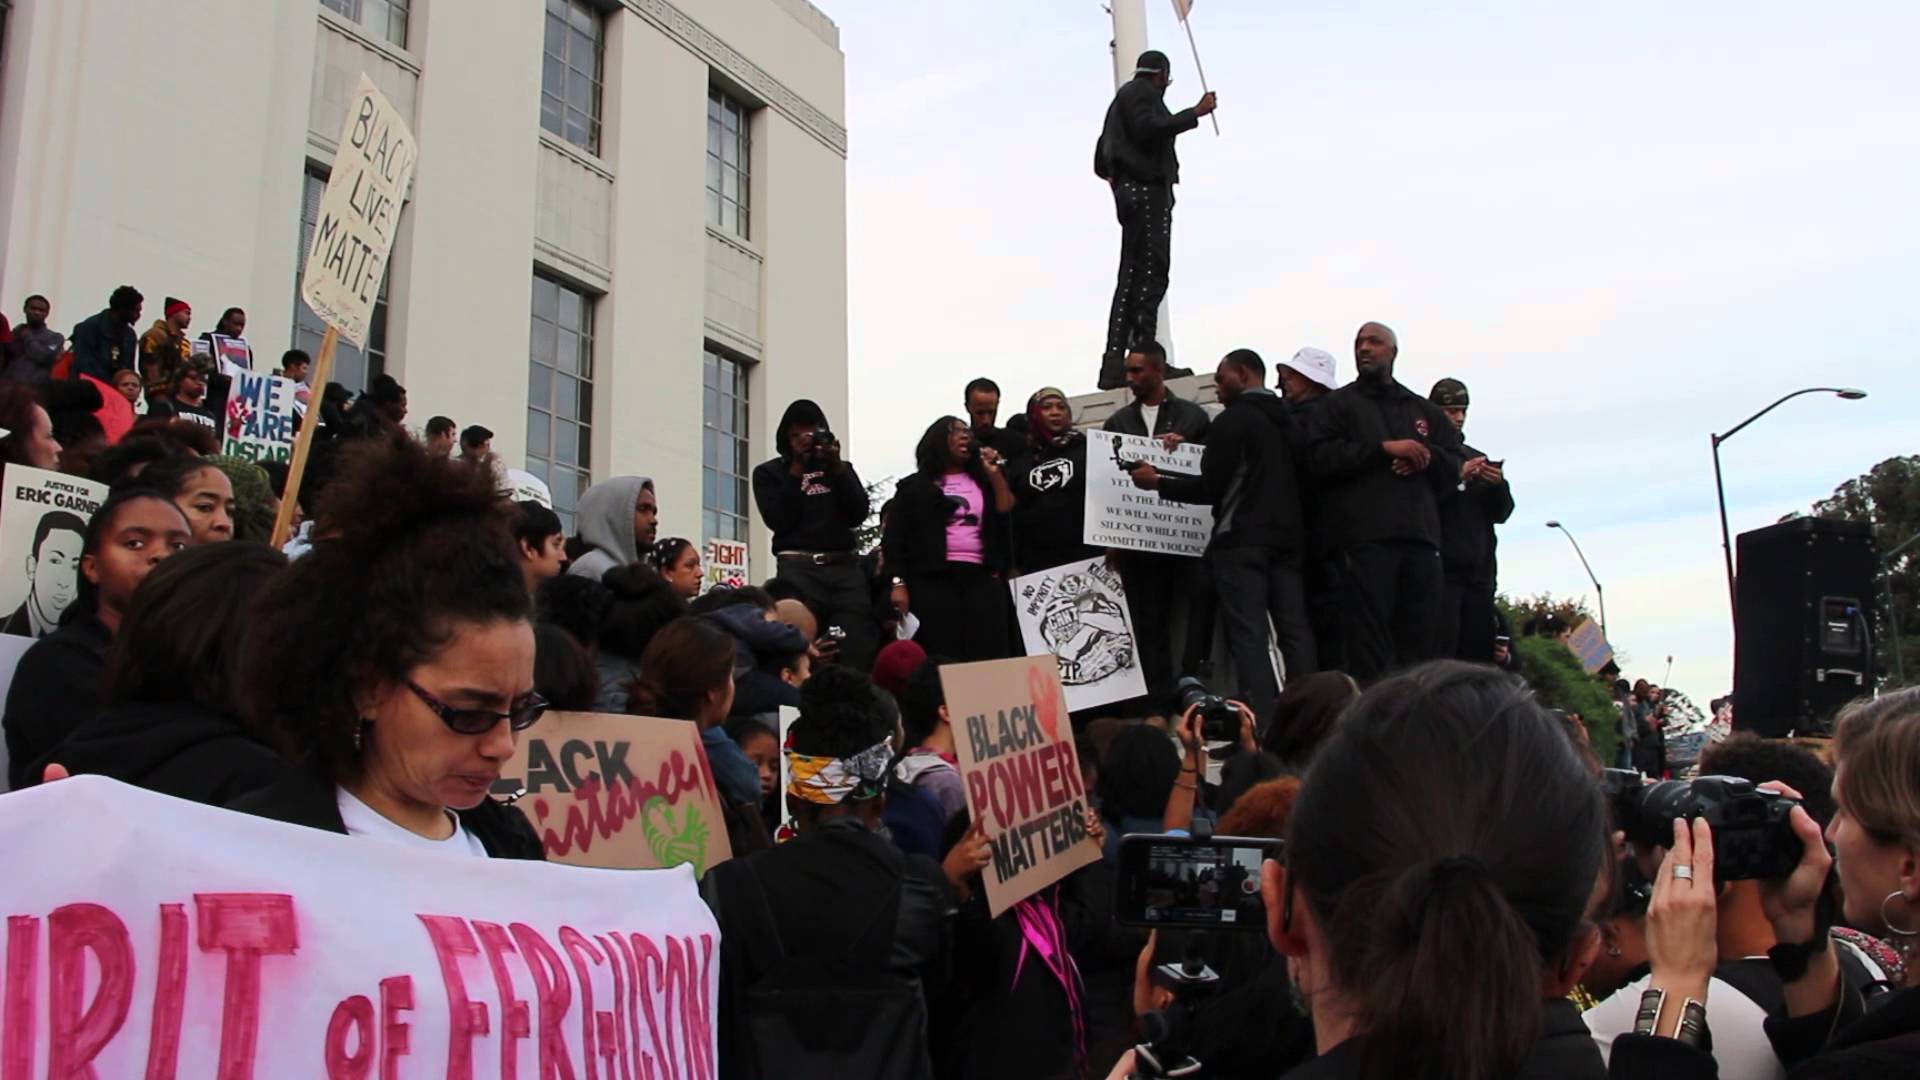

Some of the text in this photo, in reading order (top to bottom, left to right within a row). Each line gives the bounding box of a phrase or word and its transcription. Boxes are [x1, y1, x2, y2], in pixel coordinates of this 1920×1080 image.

[314, 212, 379, 304] MATTE
[239, 373, 282, 413] WE
[243, 410, 293, 444] ARE
[1150, 440, 1163, 449] AN
[1160, 456, 1193, 468] NEVER
[44, 480, 89, 496] JUSTICE FOR
[1111, 477, 1130, 488] YET
[16, 486, 100, 514] ERIC GARNE
[1121, 493, 1133, 503] IN
[1135, 495, 1154, 506] THE
[1105, 506, 1203, 526] WE WILL NOT SIT IN
[1100, 520, 1207, 541] SILENCE WHILE THEY
[1092, 533, 1205, 554] COMMIT THE VIOLENC
[1022, 584, 1036, 600] NO
[966, 704, 1044, 763] BLACK
[967, 740, 1083, 834] POWER
[991, 800, 1087, 883] MATTERS
[0, 893, 714, 1080] IRIT OF FERGUSON
